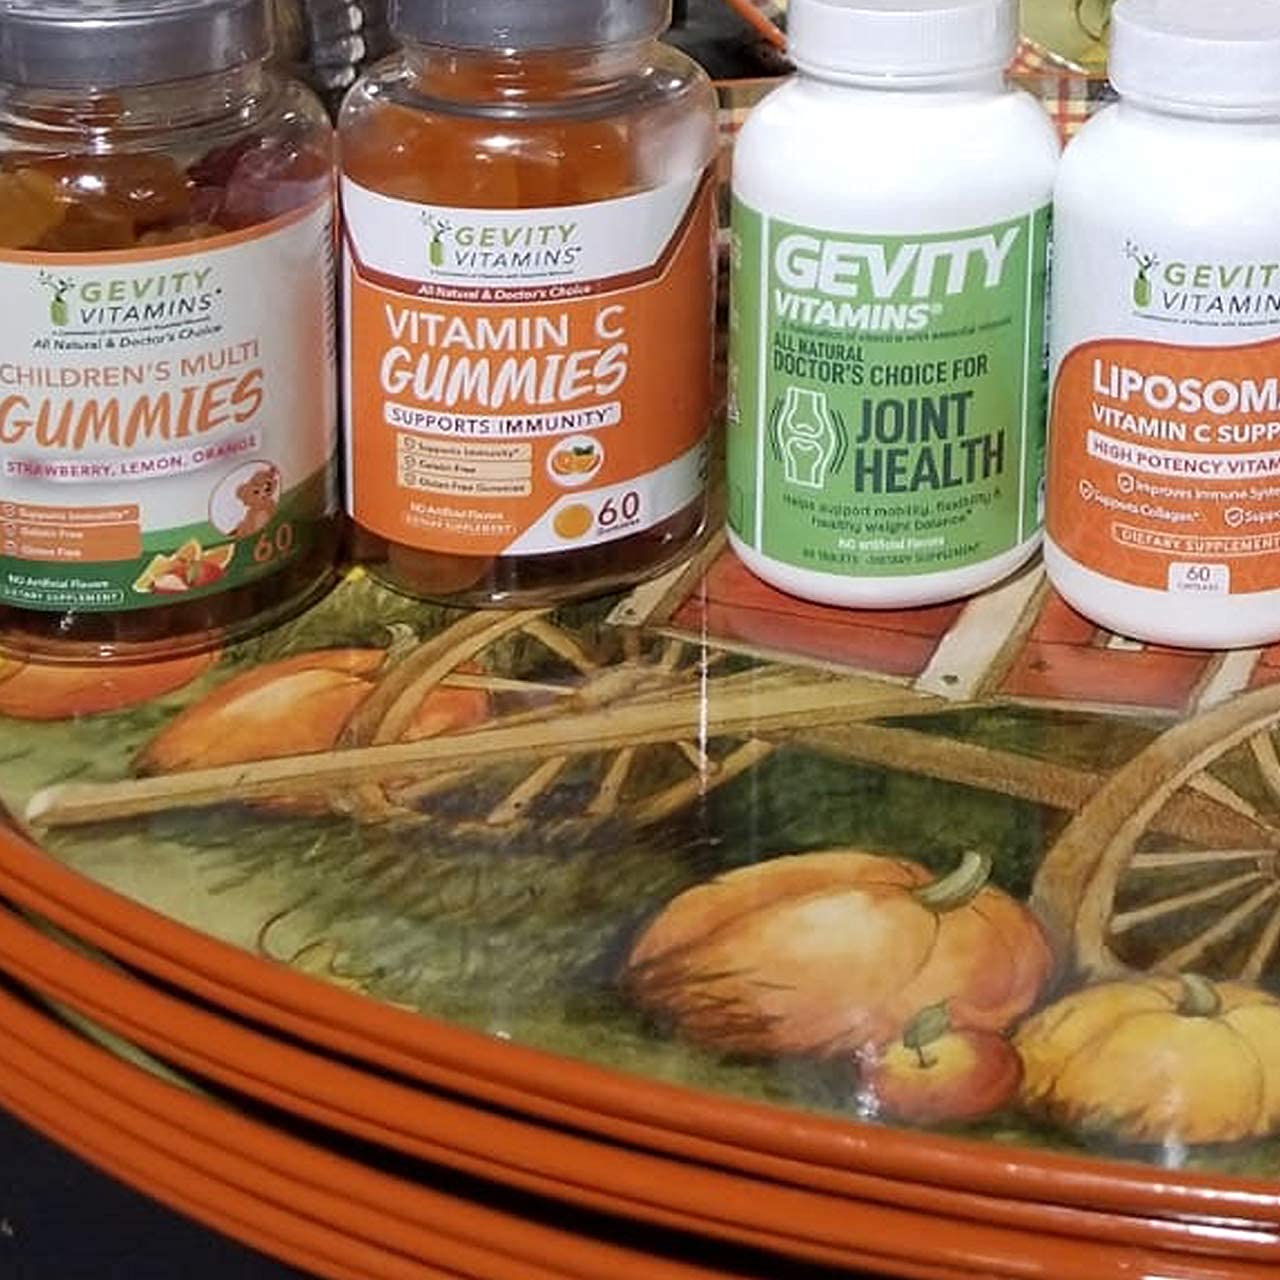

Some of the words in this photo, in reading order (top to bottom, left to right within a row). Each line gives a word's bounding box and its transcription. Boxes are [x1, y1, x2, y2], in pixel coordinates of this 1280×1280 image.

[455, 223, 577, 248] GEVITY
[455, 247, 578, 267] VITAMINS
[774, 226, 1022, 299] GEVITY
[80, 267, 212, 303] GEVITY
[80, 293, 212, 325] VITAMINS
[384, 303, 569, 351] VITAMIN
[594, 303, 626, 340] C
[774, 290, 932, 331] VITAMINS
[0, 361, 171, 389] CHILDREN'S
[180, 339, 261, 378] MULTI
[773, 350, 865, 387] DOCTOR'S
[870, 361, 947, 387] CHOICE
[952, 354, 989, 381] FOR
[798, 338, 865, 363] NATURAL
[380, 342, 629, 409] GUMMIES
[0, 368, 265, 451] GUMMIES
[391, 406, 491, 434] SUPPORTS
[856, 390, 975, 444] JOINT
[1092, 402, 1187, 442] VITAMIN
[1193, 424, 1213, 444] C
[854, 430, 1005, 494] HEALTH
[1093, 438, 1133, 462] HIGH
[1136, 453, 1222, 475] POTENCY
[598, 492, 640, 526] 60
[253, 522, 293, 563] 60
[1120, 529, 1181, 550] DIETARY
[1186, 567, 1211, 582] 60
